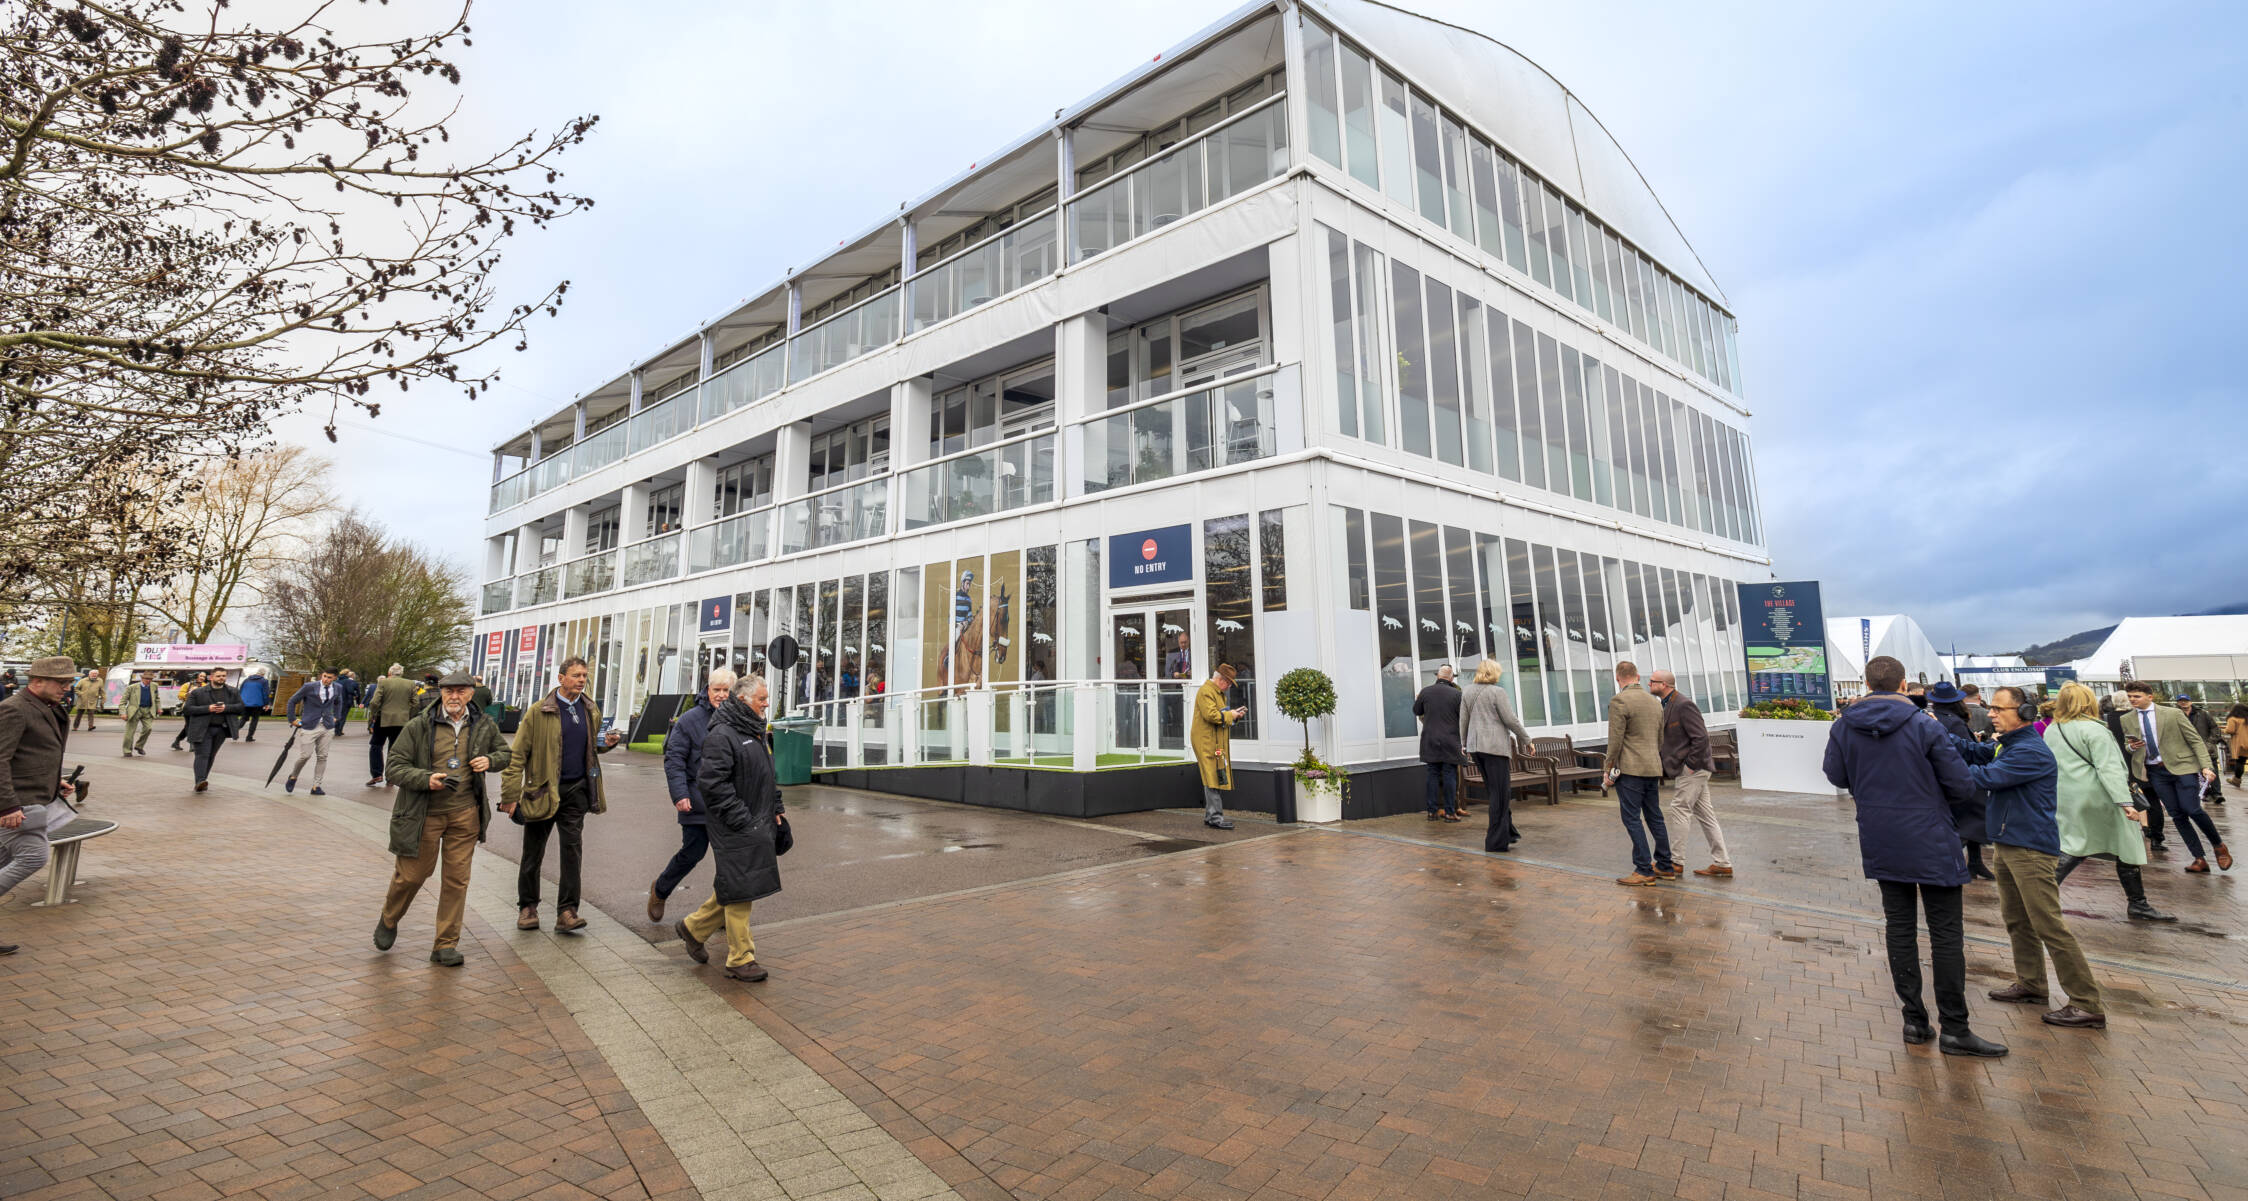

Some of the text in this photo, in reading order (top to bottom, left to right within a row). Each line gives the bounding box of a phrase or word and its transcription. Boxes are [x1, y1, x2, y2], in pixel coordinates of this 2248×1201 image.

[1134, 561, 1167, 575] NO ENTRY
[1764, 599, 1796, 608] THE VILLAGE
